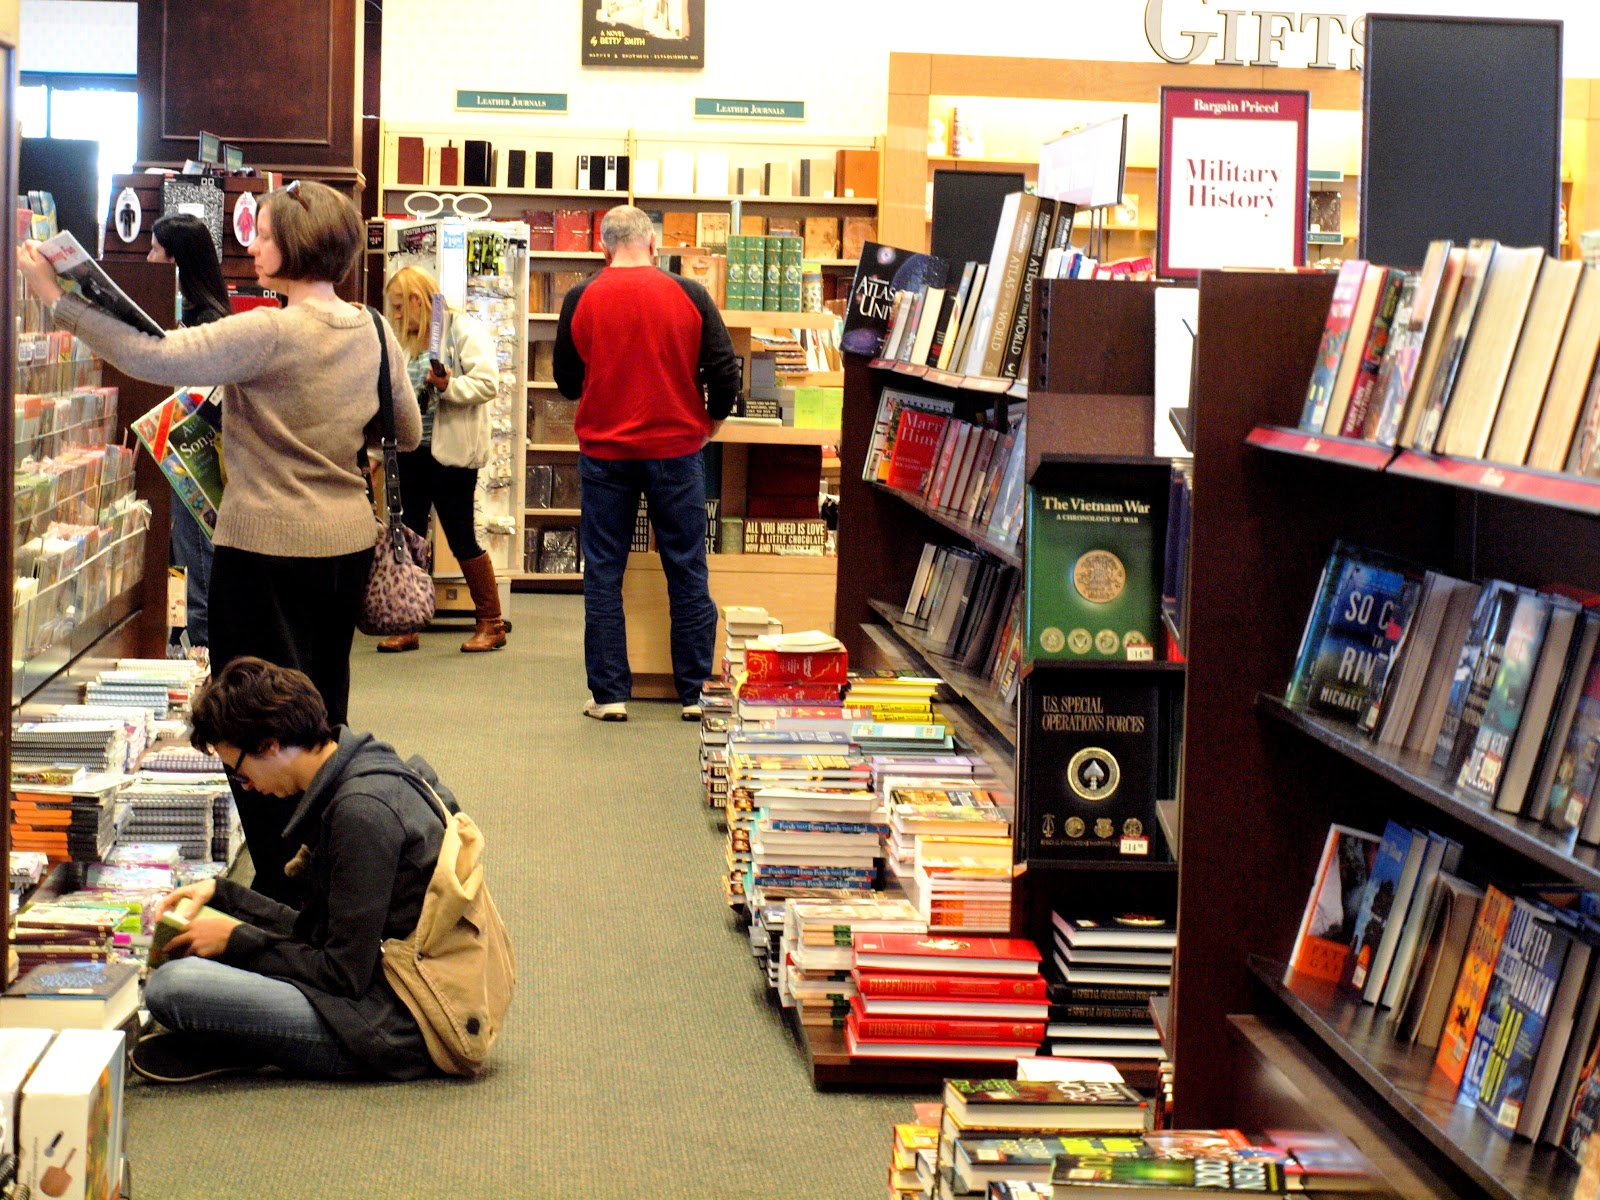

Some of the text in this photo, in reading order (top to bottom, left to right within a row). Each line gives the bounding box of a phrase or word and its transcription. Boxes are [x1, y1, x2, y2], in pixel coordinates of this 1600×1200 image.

[600, 37, 622, 45] BETTY
[623, 37, 646, 46] SMITH
[477, 95, 547, 107] LEATHER JOURNALS
[716, 103, 785, 115] LEATHER JOURNALS
[1194, 98, 1279, 115] Bargain Priced
[1187, 158, 1281, 190] Military
[1189, 184, 1278, 217] History
[1005, 255, 1020, 290] ATLAS
[856, 275, 897, 302] ATLAS
[991, 311, 1009, 351] WORLD
[1011, 314, 1028, 355] WORLD
[1042, 496, 1150, 514] The Vietnam War
[1062, 514, 1110, 523] CHRONOLOGY
[745, 521, 825, 536] ALL YOU NEED IS LOVE
[745, 533, 825, 545] BUT A LITTLE CHOCOLATE
[1345, 591, 1374, 625] SO
[1061, 696, 1104, 714] SPECIAL
[1041, 714, 1145, 733] OPERATIONS FORCES
